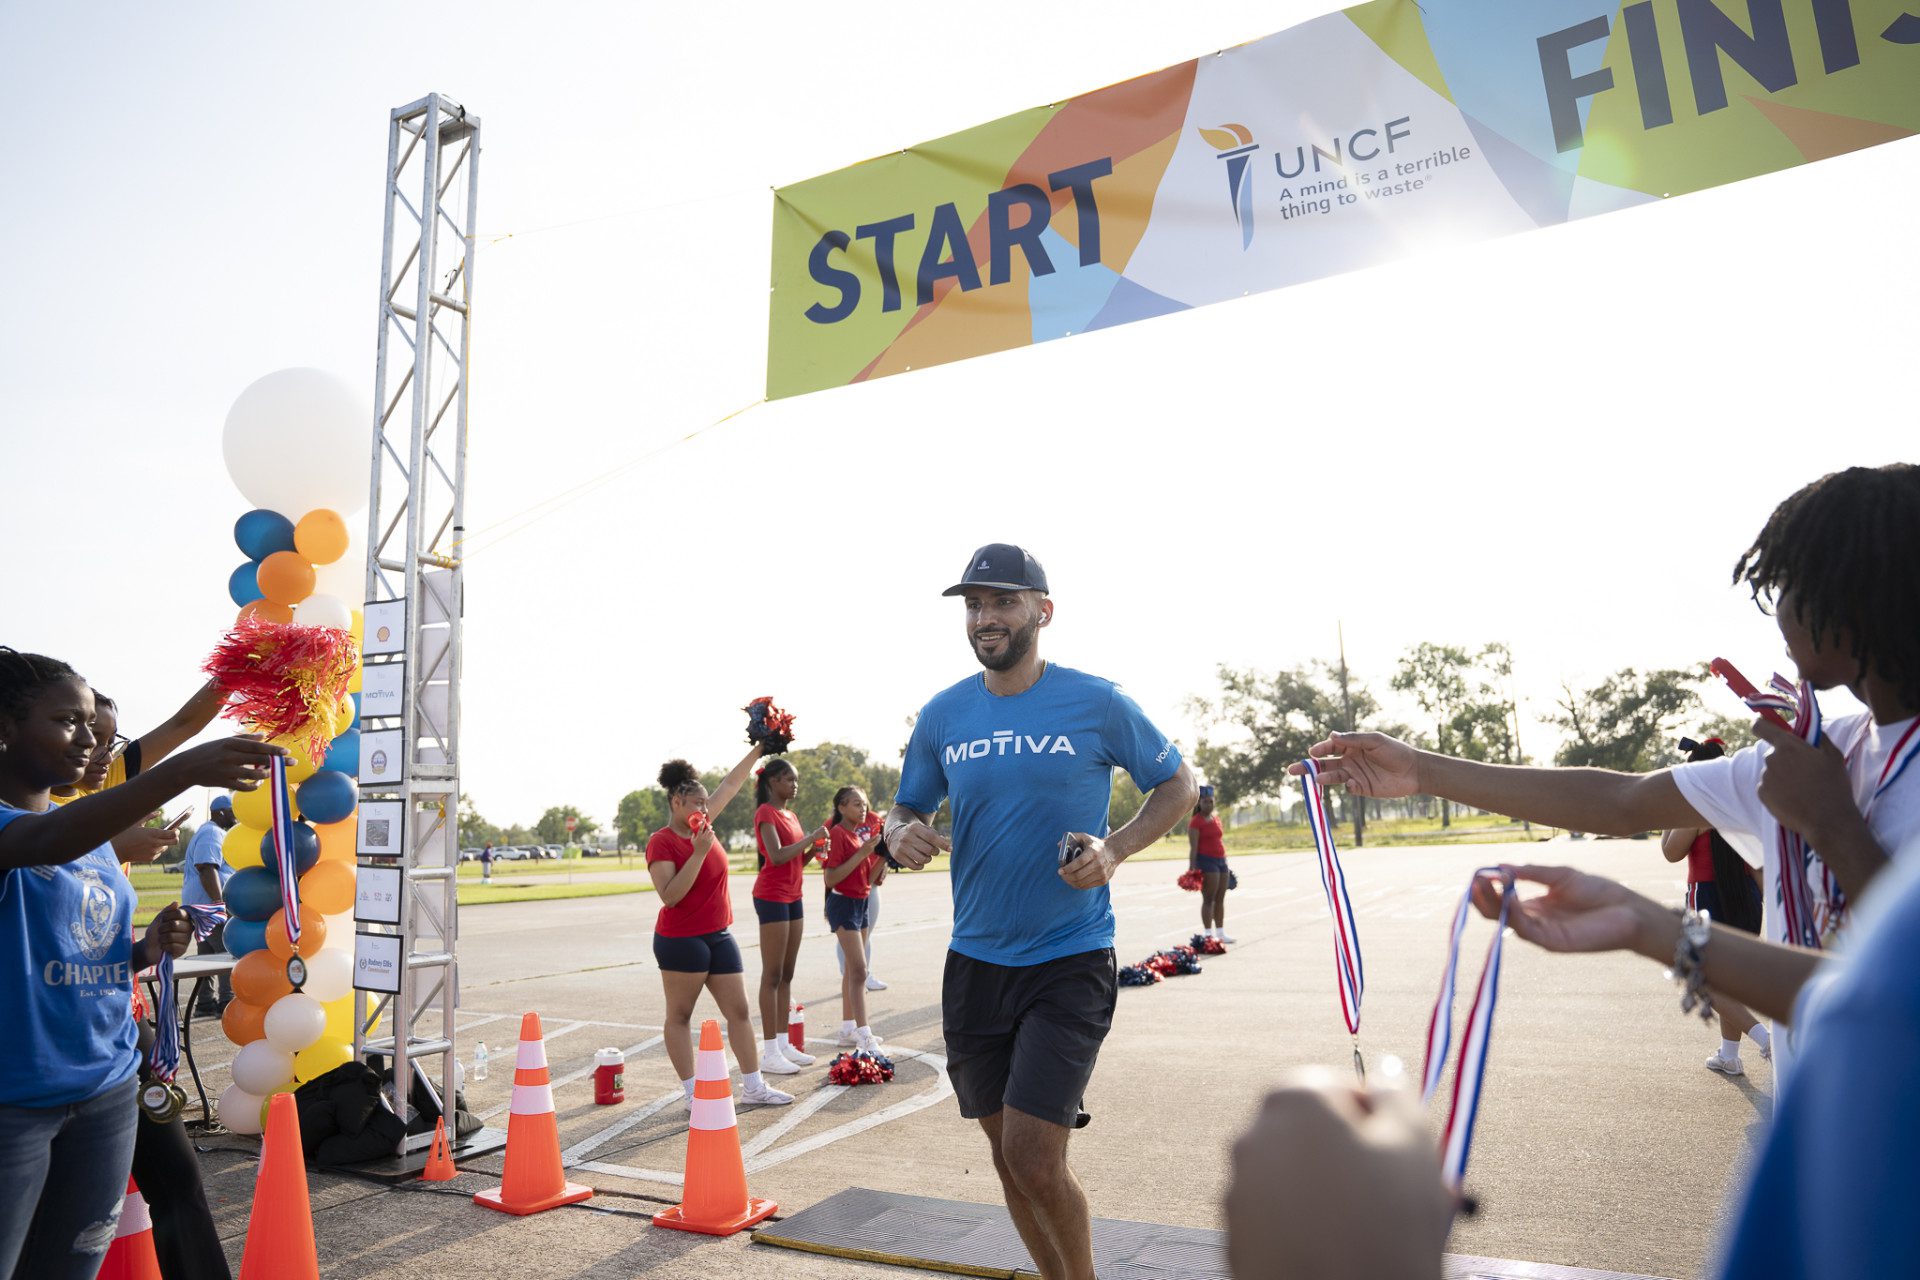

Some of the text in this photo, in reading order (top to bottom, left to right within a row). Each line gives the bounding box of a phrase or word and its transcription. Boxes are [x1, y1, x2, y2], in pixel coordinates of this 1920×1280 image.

[1536, 0, 1920, 155] FINI
[1274, 115, 1411, 179] UNCF
[1279, 146, 1471, 202] A mind is a terrible
[1280, 197, 1331, 221] thing
[1337, 192, 1357, 206] to
[804, 156, 1113, 325] START
[366, 689, 395, 699] MOTIVA
[945, 730, 1077, 766] MOTIVA
